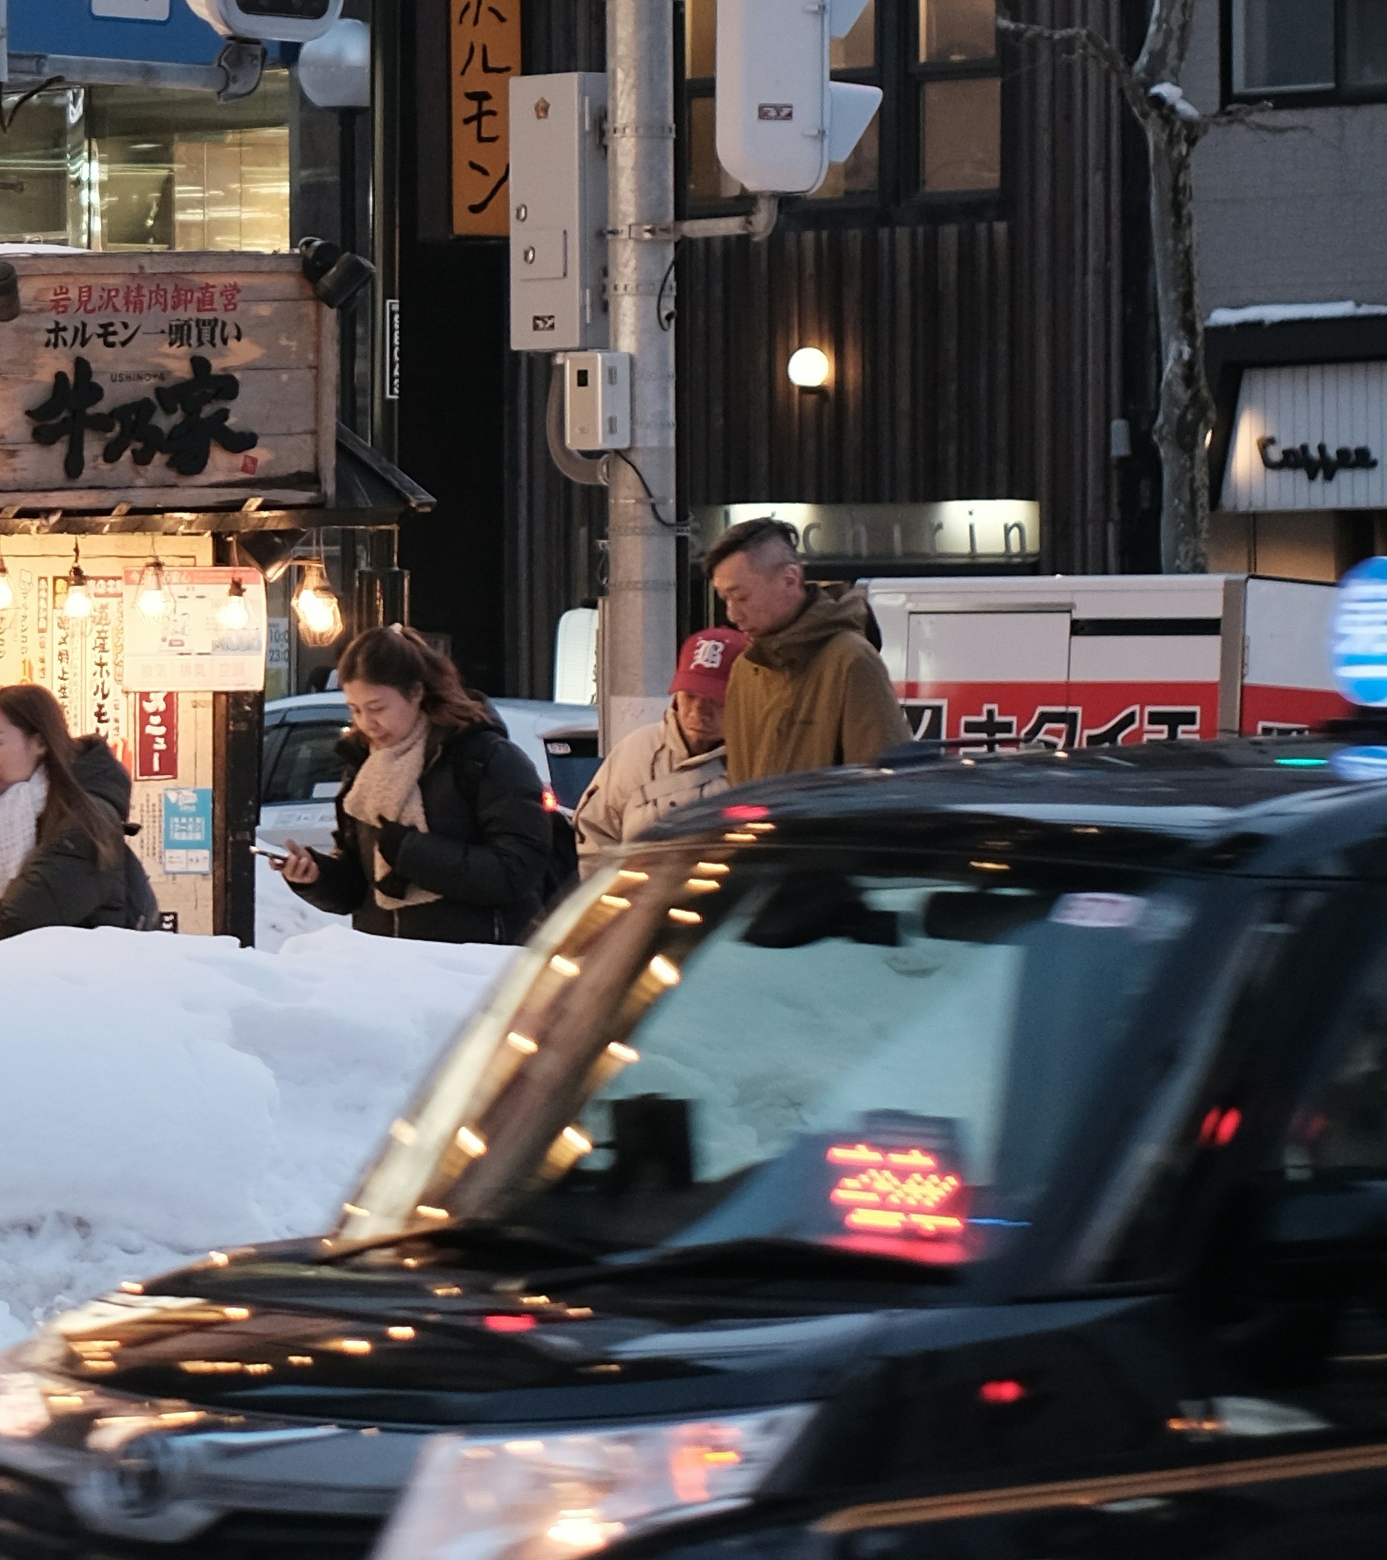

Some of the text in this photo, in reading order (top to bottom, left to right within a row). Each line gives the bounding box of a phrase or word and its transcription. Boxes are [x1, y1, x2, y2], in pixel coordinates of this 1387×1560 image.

[49, 281, 242, 316] 岩見沢精肉卸直営
[44, 316, 243, 350] ホルモン一頭買い
[24, 354, 259, 480] 牛乃家
[1257, 435, 1378, 482] Coffee
